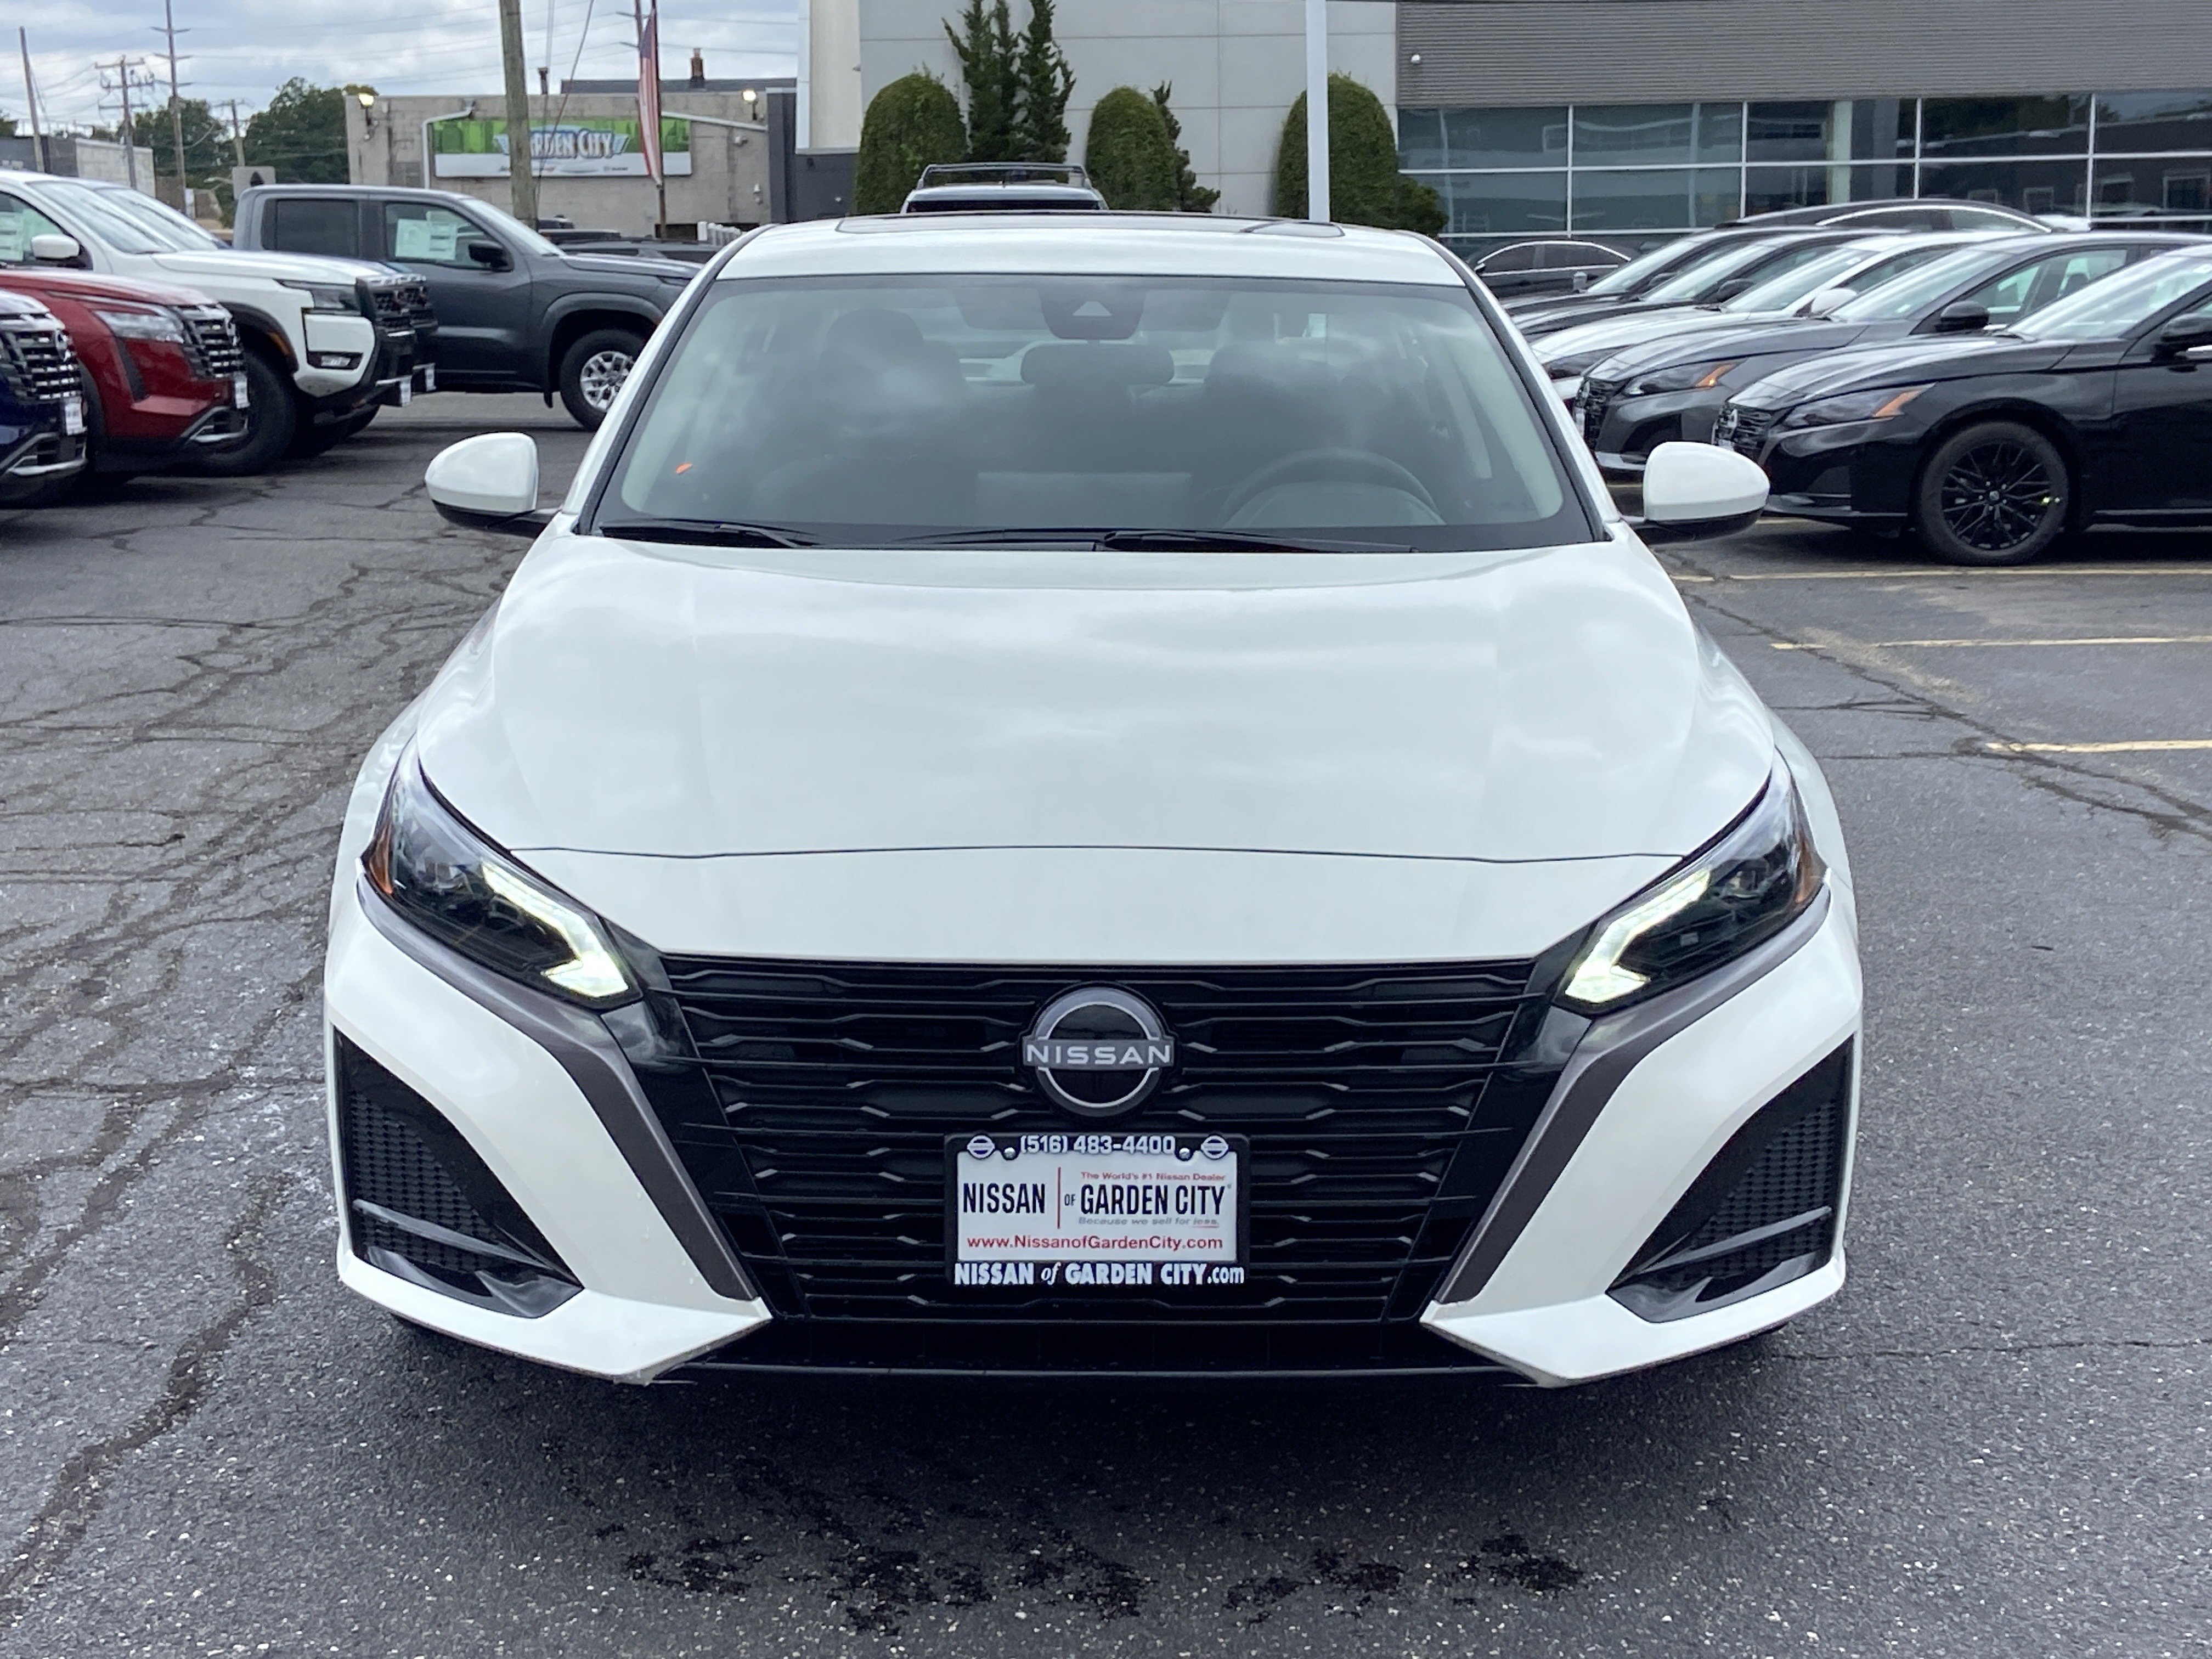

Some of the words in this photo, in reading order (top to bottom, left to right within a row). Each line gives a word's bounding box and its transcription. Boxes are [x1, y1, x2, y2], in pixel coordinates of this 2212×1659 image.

[578, 129, 613, 158] CITY
[1026, 1044, 1171, 1065] NISSAN
[1020, 1135, 1068, 1154] (516)
[1073, 1135, 1176, 1155] 483-4400
[1081, 1171, 1099, 1180] The
[1102, 1172, 1139, 1180] World's
[1156, 1172, 1190, 1181] Nissan
[1193, 1173, 1226, 1181] Dealer
[963, 1182, 1046, 1214] NISSAN
[1064, 1193, 1076, 1206] OF
[1081, 1183, 1168, 1215] GARDEN
[1176, 1185, 1225, 1215] CITY
[1079, 1217, 1127, 1225] Because
[967, 1235, 1223, 1251] www.NissanofGardenCity.com
[954, 1262, 1035, 1285] NISSAN
[1041, 1262, 1062, 1285] of
[1065, 1262, 1152, 1285] GARDEN
[1160, 1263, 1245, 1285] CITY.com
